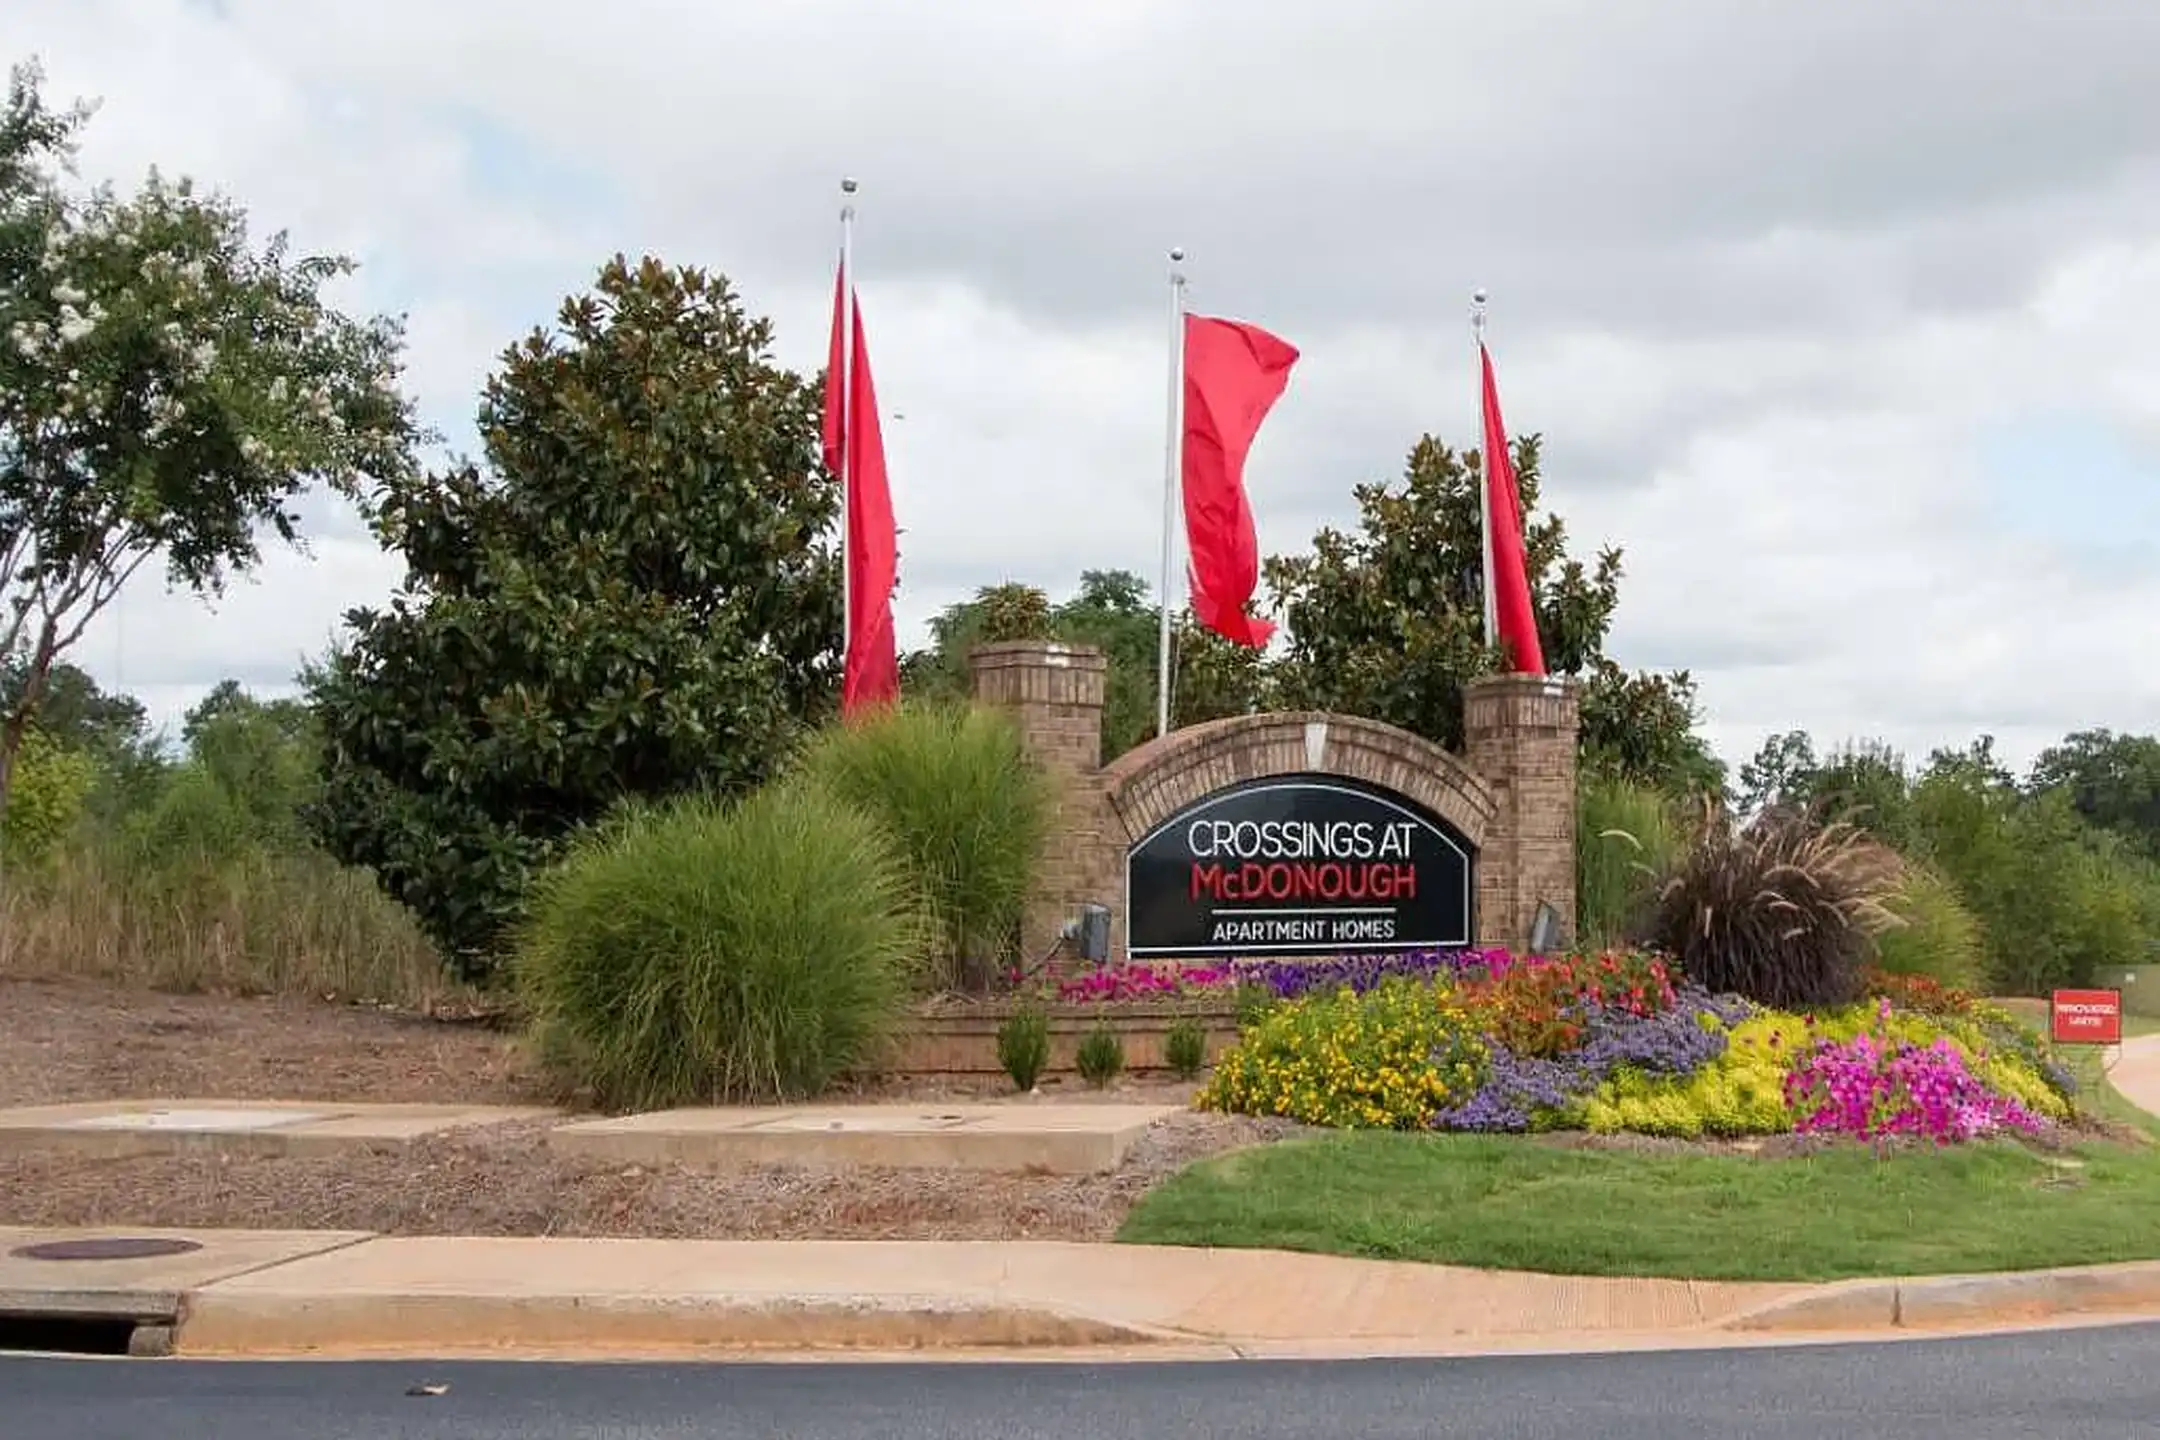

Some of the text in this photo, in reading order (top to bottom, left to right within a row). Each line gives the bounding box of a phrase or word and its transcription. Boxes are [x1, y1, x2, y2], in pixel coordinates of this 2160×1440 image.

[1188, 820, 1418, 859] CROSSINGS AT
[1190, 861, 1417, 899] McDONOUGH
[1212, 918, 1396, 942] APARTMENT HOMES
